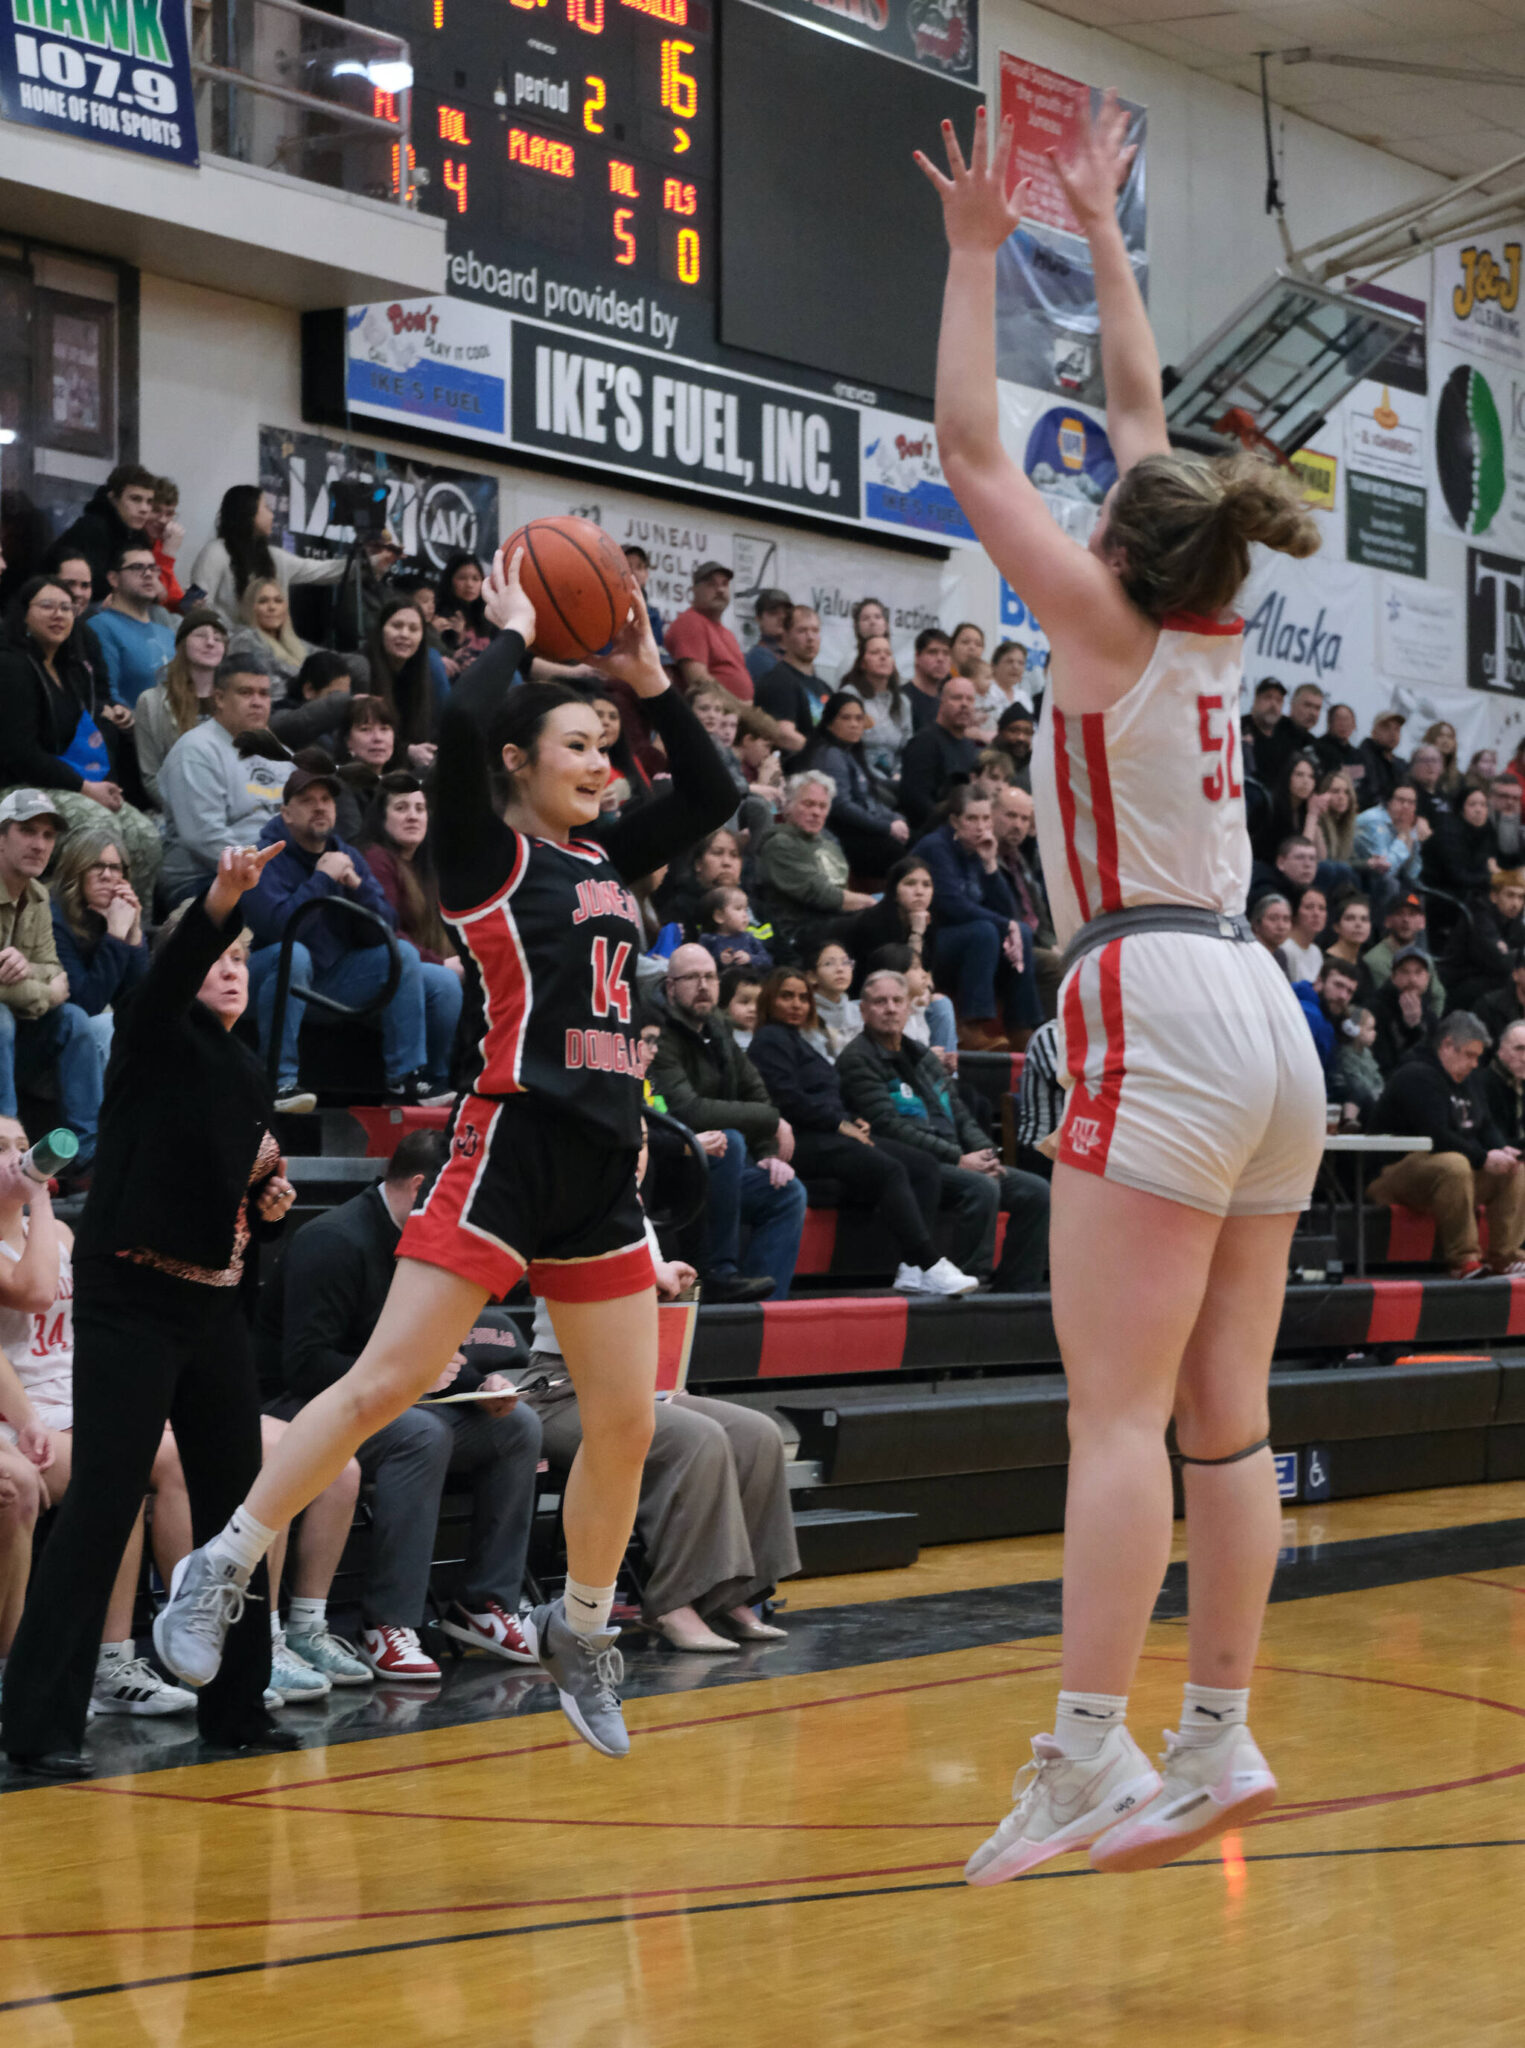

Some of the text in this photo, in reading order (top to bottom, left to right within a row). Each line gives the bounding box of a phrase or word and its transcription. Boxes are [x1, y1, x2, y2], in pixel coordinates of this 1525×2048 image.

[15, 33, 178, 114] 107.9
[514, 73, 606, 134] period 2
[660, 40, 698, 119] 16
[20, 81, 182, 149] HOME OF FOX SPORTS
[508, 128, 575, 178] PLAYER
[443, 159, 468, 214] 4
[613, 207, 637, 266] 5
[677, 227, 700, 285] 0
[544, 280, 646, 334] provided
[650, 301, 679, 351] by
[1453, 243, 1522, 320] J&J
[433, 386, 483, 414] FUEL
[535, 345, 840, 498] IKE'S FUEL, INC.
[624, 519, 707, 552] JUNEAU
[811, 586, 850, 618] Valu
[1242, 590, 1342, 678] Alaska
[572, 878, 641, 929] JUNEA
[591, 936, 632, 1024] 14
[565, 1028, 647, 1081] DOUGLA
[31, 1312, 68, 1357] 34
